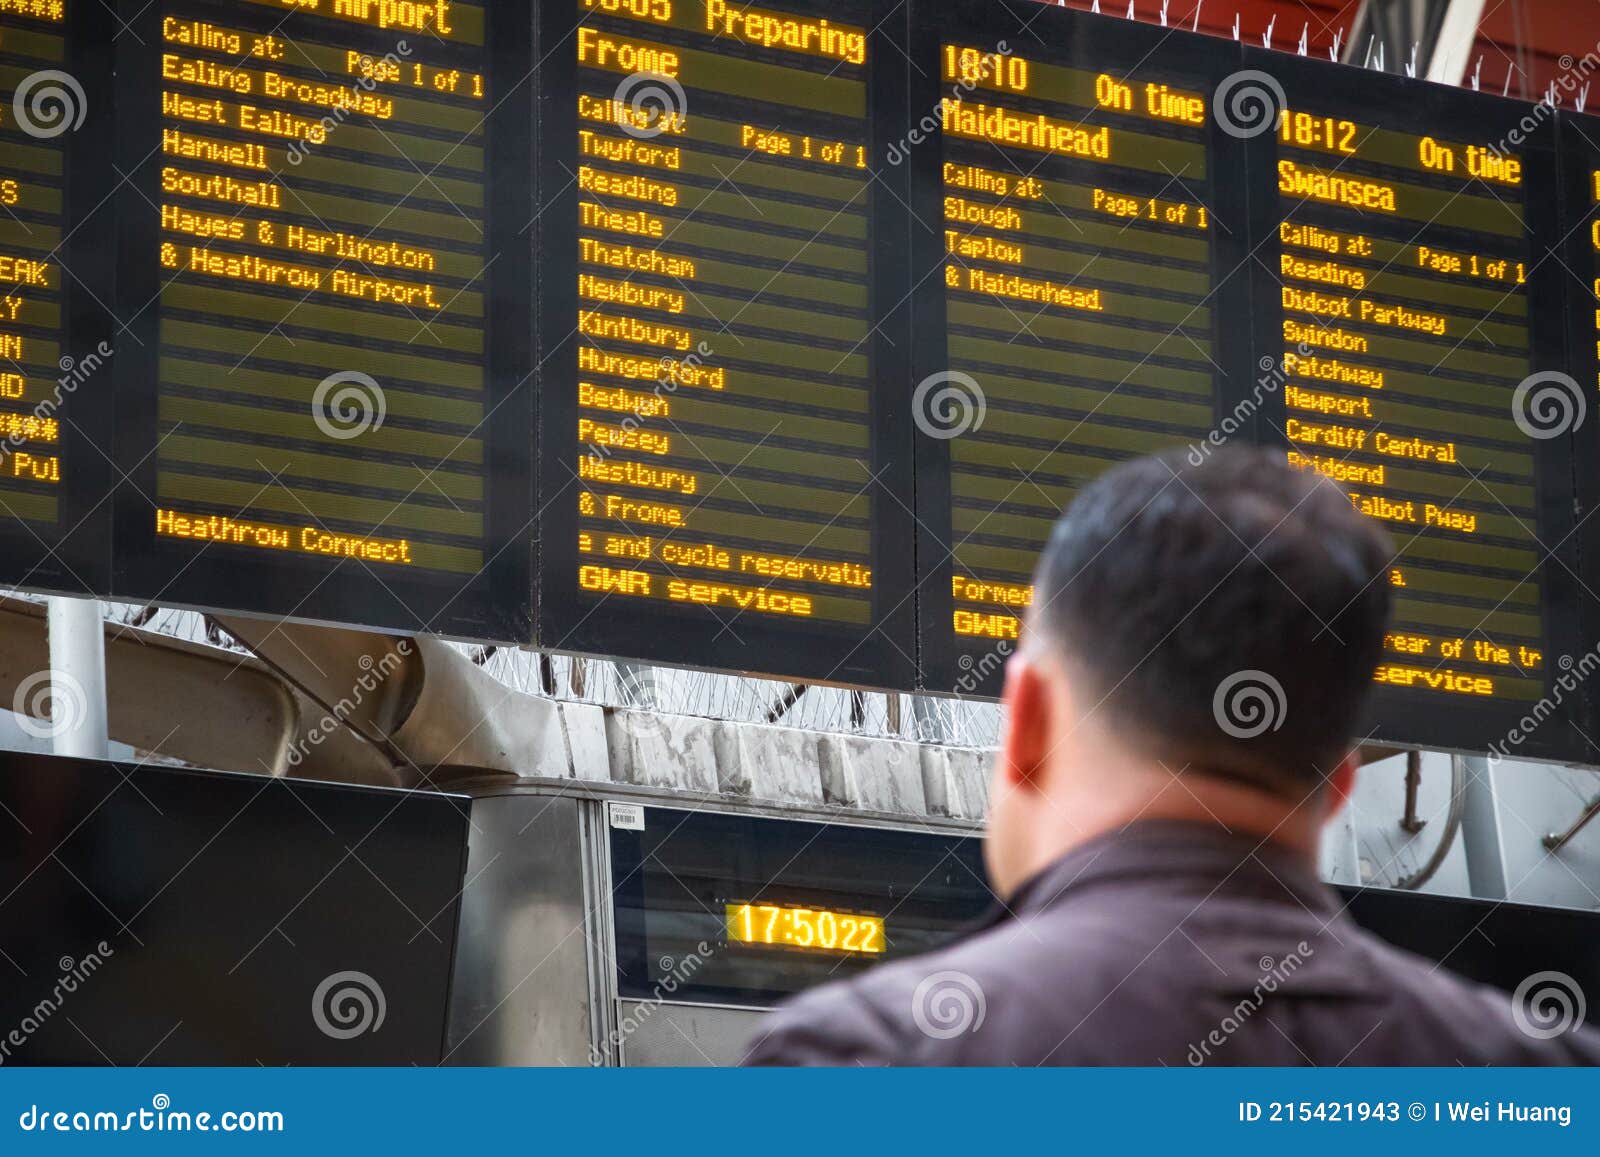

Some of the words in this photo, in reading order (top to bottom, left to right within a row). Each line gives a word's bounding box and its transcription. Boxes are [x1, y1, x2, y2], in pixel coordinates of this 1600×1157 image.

[164, 18, 239, 53] Calling
[252, 36, 282, 58] at:
[708, 0, 864, 63] Preparing
[579, 28, 677, 78] Frome
[164, 55, 250, 93] Ealing
[266, 73, 391, 118] Broadway
[348, 51, 399, 81] Page
[414, 64, 423, 85] 1
[435, 71, 459, 91] of
[474, 75, 482, 96] 1
[946, 46, 1026, 90] 18:10
[1097, 75, 1131, 110] On
[1146, 84, 1203, 122] time
[163, 92, 225, 123] West
[241, 106, 325, 143] Ealing
[579, 96, 648, 130] Calling
[658, 112, 685, 133] at:
[942, 98, 1108, 158] Maidenhead
[164, 130, 266, 168] Hanwell
[580, 131, 678, 168] Twyford
[744, 126, 790, 153] Page
[803, 137, 811, 157] 1
[822, 143, 843, 162] of
[857, 147, 865, 167] 1
[1281, 110, 1355, 152] 18:12
[1420, 138, 1452, 170] On
[1467, 146, 1520, 182] time
[163, 168, 279, 207] Southall
[580, 167, 676, 206] Reading
[944, 163, 1006, 194] Calling
[1016, 178, 1041, 198] at:
[1279, 161, 1395, 210] Swansea
[580, 203, 662, 236] Theale
[945, 198, 1020, 228] Slough
[1095, 189, 1137, 216] Page
[1149, 199, 1156, 218] 1
[1167, 205, 1186, 223] of
[1199, 208, 1206, 227] 1
[162, 205, 243, 238] Hayes
[259, 221, 273, 244] &
[289, 226, 433, 269] Harlington
[945, 231, 1021, 262] Taplow
[1281, 223, 1338, 252] Calling
[1347, 236, 1370, 255] at:
[161, 243, 176, 266] &
[192, 248, 319, 288] Heathrow
[333, 271, 440, 307] Airport.
[580, 239, 693, 277] Thatcham
[1281, 255, 1364, 289] Reading
[1420, 247, 1460, 272] Page
[1471, 256, 1478, 274] 1
[1487, 261, 1506, 278] of
[1517, 264, 1524, 282] 1
[580, 275, 682, 313] Newbury
[946, 266, 958, 286] &
[970, 270, 1102, 309] Maidenhead.
[1283, 288, 1351, 316] Didcot
[1361, 301, 1444, 334] Parkway
[0, 335, 20, 358] N
[579, 311, 689, 350] Kintbury
[1284, 321, 1366, 351] Swindon
[0, 374, 22, 397] D
[580, 347, 723, 388] Hungerford
[1285, 353, 1382, 388] Patchway
[580, 383, 668, 416] Bedwyn
[1286, 386, 1371, 417] Newport
[579, 419, 668, 454] Pewsey
[1287, 420, 1365, 448] Cardiff
[1376, 433, 1455, 462] Central
[580, 456, 695, 493] Westbury
[1288, 453, 1383, 484] Bridgend
[580, 493, 594, 514] &
[607, 496, 685, 526] Frome.
[1426, 505, 1474, 532] Pway
[158, 510, 288, 546] Heathrow
[302, 528, 410, 562] Connect
[605, 537, 650, 557] and
[663, 545, 729, 568] cycle
[580, 566, 649, 594] GWR
[668, 582, 810, 614] service
[953, 577, 1034, 606] Formed
[954, 611, 1017, 637] GWR
[1441, 639, 1462, 657] of
[1474, 642, 1509, 663] the
[1519, 647, 1540, 666] tr
[1375, 668, 1492, 694] service
